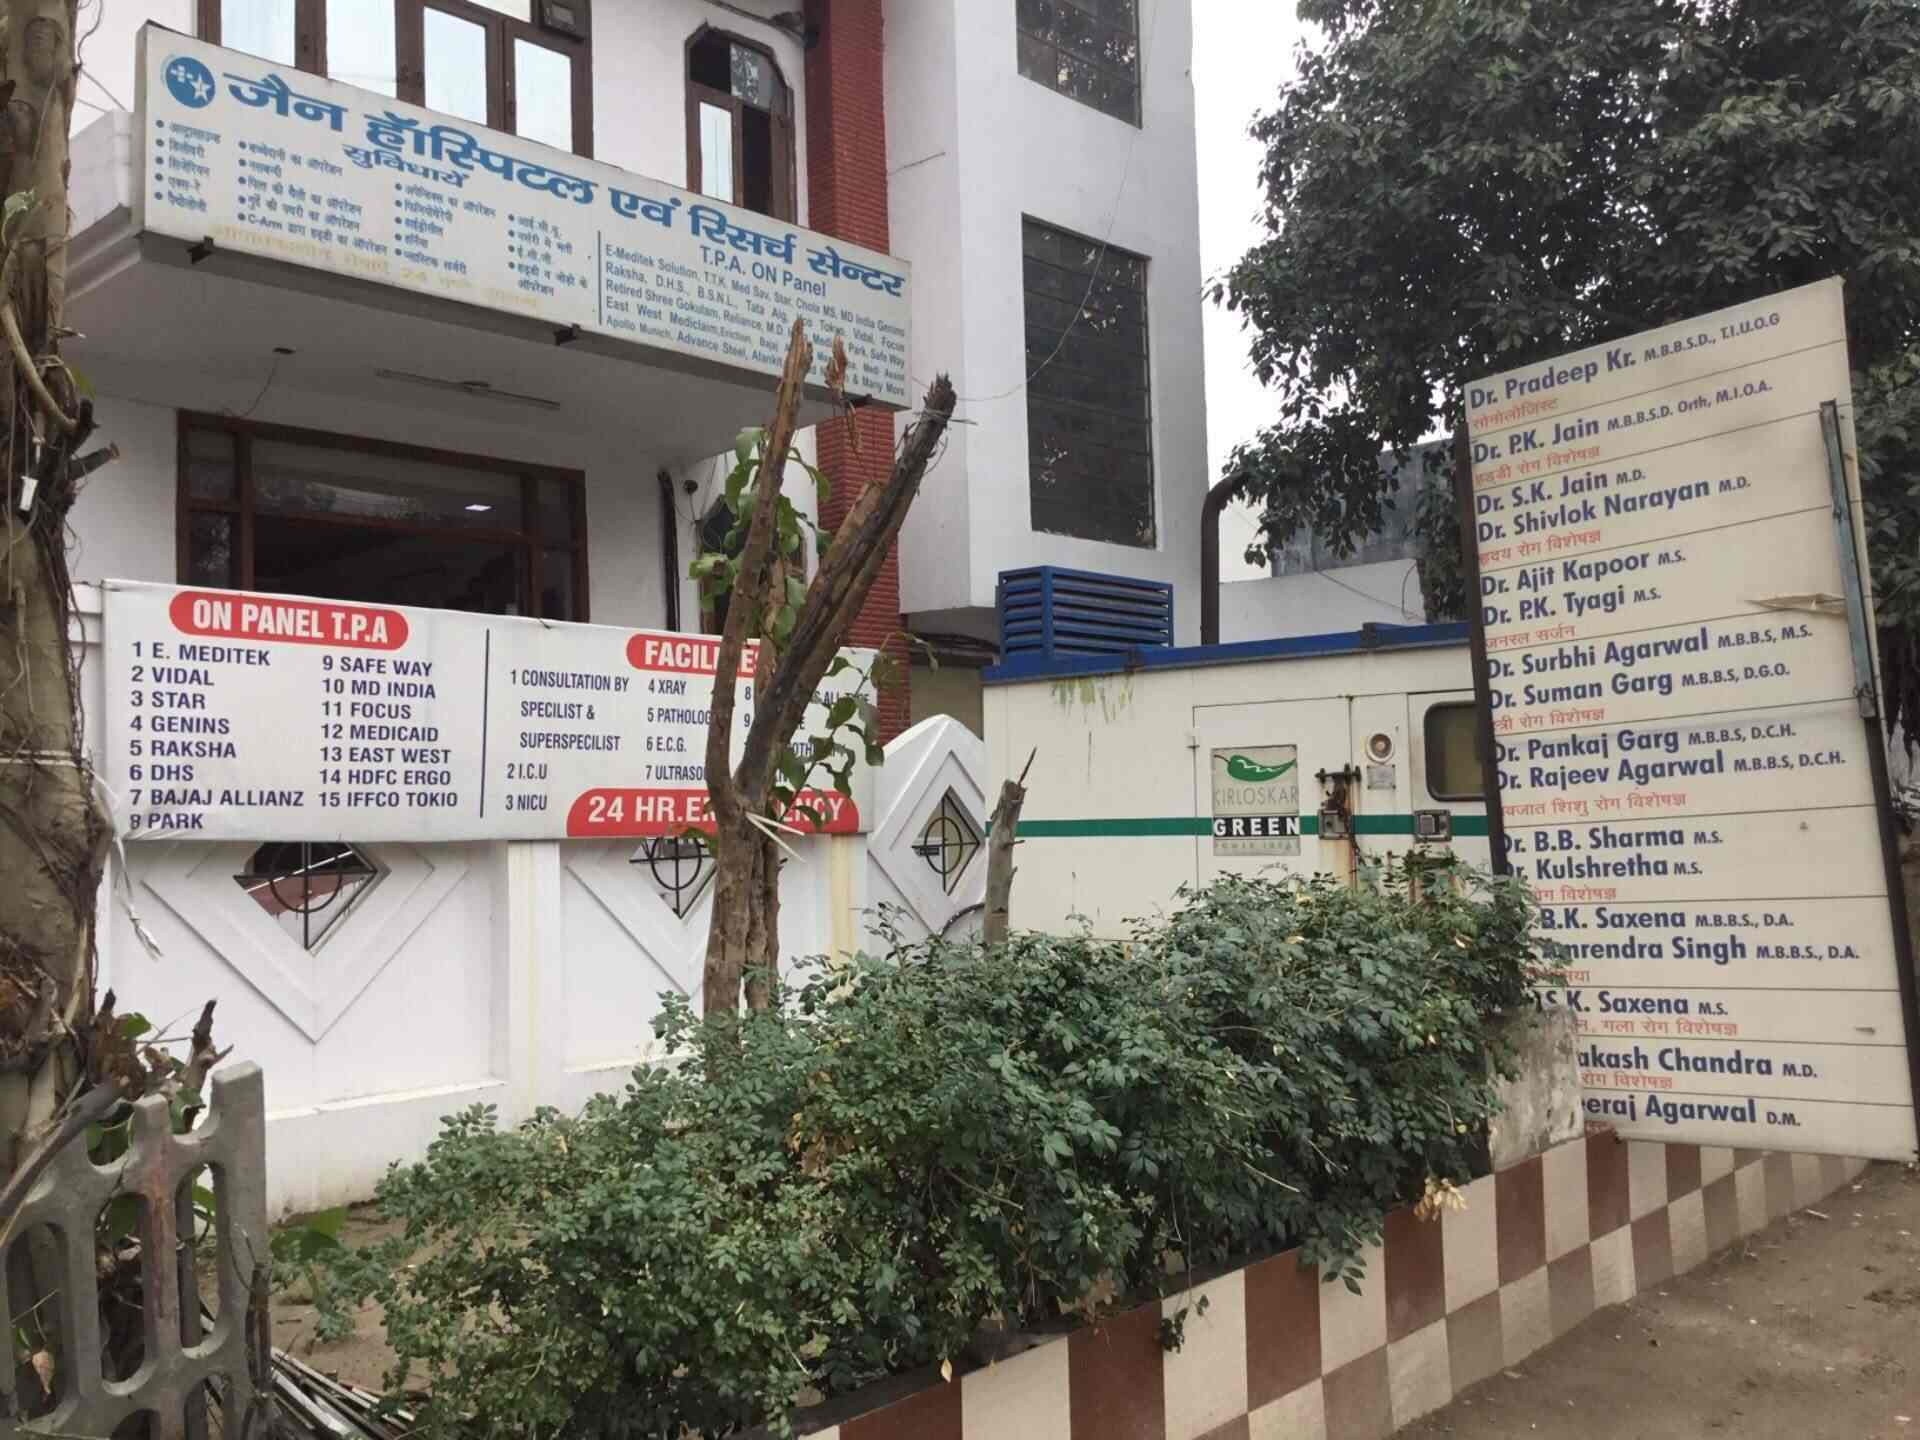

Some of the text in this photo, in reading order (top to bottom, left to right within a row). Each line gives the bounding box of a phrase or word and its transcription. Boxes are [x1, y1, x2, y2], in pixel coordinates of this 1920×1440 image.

[223, 74, 348, 132] जैन
[364, 110, 598, 204] हॉस्पिटल
[608, 187, 682, 228] एवं
[687, 203, 798, 264] रिसर्च
[806, 245, 905, 298] सेन्टर
[700, 245, 826, 297] T.P.A. ON Panel
[1470, 388, 1498, 408] Dr.
[1505, 361, 1598, 399] Pradeep
[1607, 349, 1636, 371] Kr.
[1473, 379, 1773, 464] Dr. P.K. Jain Orth, M.I.O.A.
[1476, 469, 1646, 515] Dr. S.K. Jain M.D.
[1479, 476, 1751, 543] Dr. Shivlok Narayan M.D.
[1482, 550, 1687, 596] Dr. Ajit Kapoor M.S.
[1482, 585, 1662, 627] Dr. P.K. Tyagi M.S.
[193, 600, 388, 644] ON PANEL T.P.A
[132, 641, 271, 666] 1 E. MEDITEK
[1488, 624, 1813, 679] Dr. Surbhi Agarwal M.S.
[131, 666, 215, 686] 2 VIDAL
[322, 655, 433, 677] 9 SAFE WAY
[322, 679, 436, 698] 10 MD INDIA
[510, 670, 630, 692] 1 CONSULTATION BY
[648, 679, 687, 696] 4 XRAY
[1489, 663, 1790, 710] Dr. Suman Garg D.G.O.
[131, 691, 206, 709] 3 STAR
[744, 686, 752, 700] 8
[321, 702, 412, 719] 11 FOCUS
[521, 701, 596, 719] SPECILIST &
[647, 708, 654, 722] 5
[744, 713, 750, 728] 9
[130, 715, 230, 734] 4 GENINS
[321, 724, 438, 742] 12 MEDICAID
[130, 739, 237, 759] 5 RAKSHA
[520, 732, 621, 751] SUPERSPECILIST
[646, 737, 687, 752] 6 E.C.G.
[1528, 733, 1609, 760] Pankaj
[1617, 729, 1679, 754] Garg
[1751, 723, 1796, 739] D.C.H.
[320, 747, 451, 764] 13 EAST WEST
[129, 764, 194, 781] 6 DHS
[319, 770, 451, 786] 14 HDFC ERGO
[507, 764, 548, 779] 2 I.C.U
[645, 765, 653, 780] 7
[1530, 766, 1609, 791] Rajeev
[1618, 749, 1724, 786] Agarwal
[1798, 751, 1846, 767] D.C.H.
[130, 789, 304, 807] 7 BAJAJ ALLIANZ
[319, 792, 457, 807] 15 IFFCO TOKIO
[505, 795, 548, 810] 3 NICU
[588, 796, 623, 823] 24
[130, 813, 204, 830] 8 PARK
[1213, 818, 1299, 836] GREEN
[1534, 825, 1723, 851] B.B. Sharma M.S.
[1536, 853, 1703, 880] Kulshretha M.S.
[1540, 906, 1588, 930] B.K.
[1595, 906, 1686, 929] Saxena
[1763, 913, 1794, 927] D.A.
[1671, 934, 1747, 966] Singh
[1828, 945, 1859, 960] D.A.
[1598, 990, 1728, 1015] Saxena M.S.
[1658, 1048, 1818, 1078] Chandra M.D.
[1645, 1094, 1801, 1127] Agarwal D.M.
